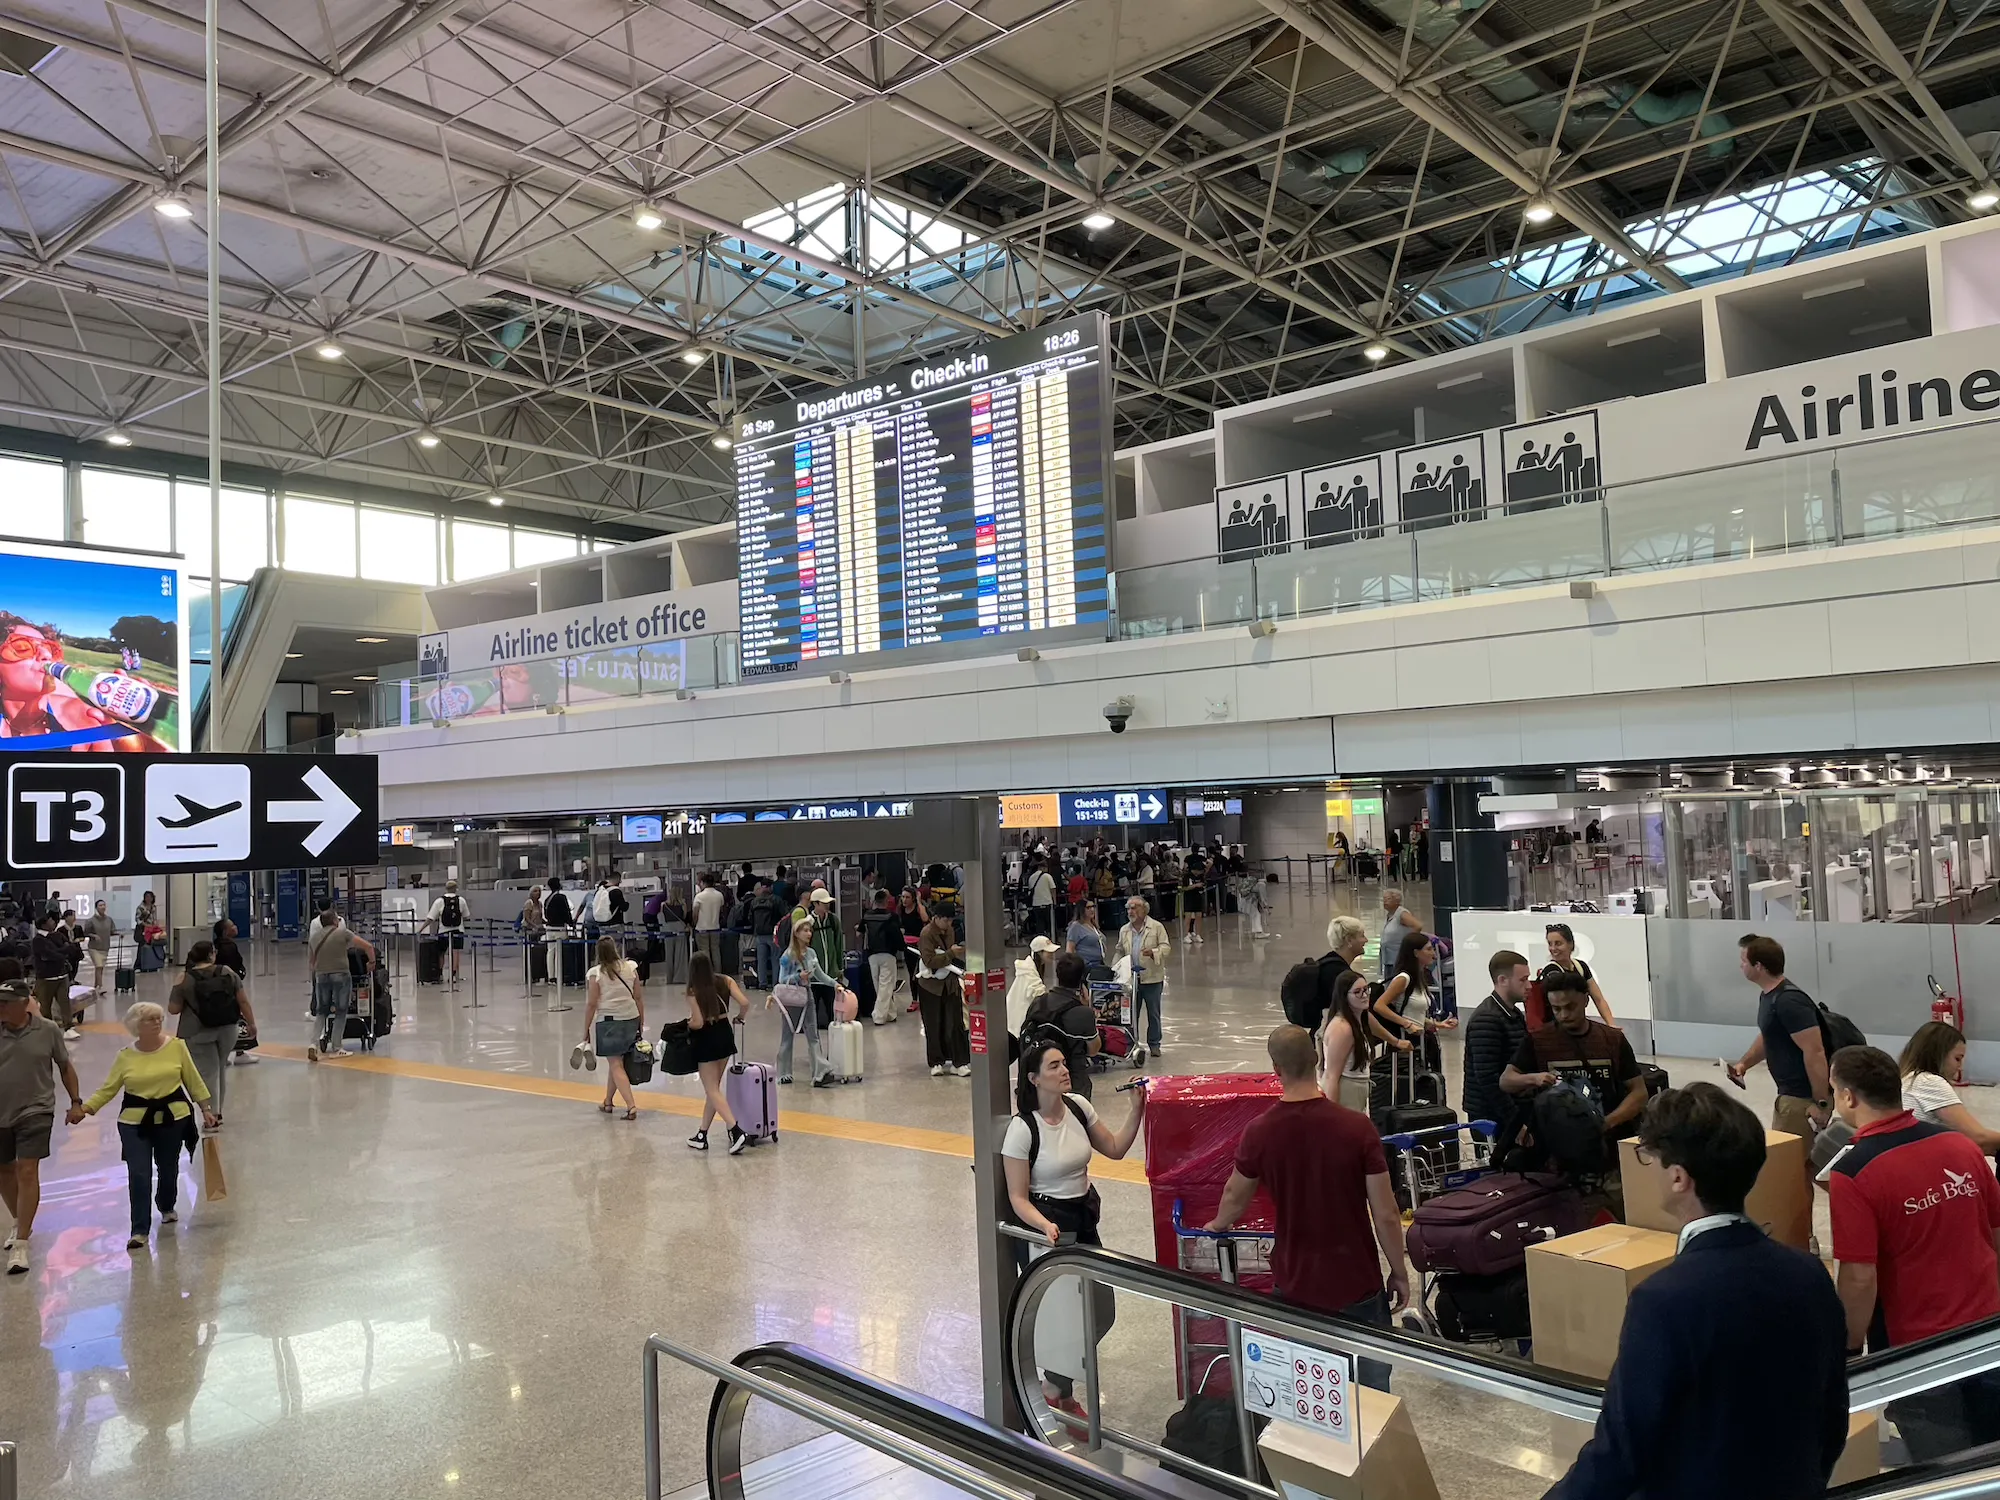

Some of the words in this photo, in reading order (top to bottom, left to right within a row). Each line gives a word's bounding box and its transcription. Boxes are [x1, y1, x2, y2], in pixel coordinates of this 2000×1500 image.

[1043, 329, 1079, 352] 18:26
[971, 383, 988, 392] Airline
[991, 376, 1007, 386] Flight
[1066, 356, 1086, 366] Status
[797, 385, 882, 421] Departures
[910, 353, 988, 389] Check-in
[1745, 368, 2000, 451] Airline
[742, 422, 753, 437] 26
[755, 419, 774, 433] Sep
[916, 440, 928, 448] Paris
[916, 449, 936, 458] Chicago
[917, 469, 928, 477] New
[928, 467, 939, 475] York
[917, 486, 946, 497] Philadelphia
[928, 506, 940, 514] York
[918, 526, 946, 536] Washington
[920, 556, 936, 565] Detroit
[921, 586, 936, 594] Dublin
[921, 596, 939, 604] London
[922, 614, 942, 623] Montreal
[490, 633, 558, 662] Airline
[564, 615, 629, 649] ticket
[636, 604, 707, 641] office
[741, 666, 776, 675] LEDWALL
[779, 663, 797, 672] T3-A
[108, 678, 133, 715] PERONI
[1008, 801, 1043, 811] Customs
[1074, 798, 1110, 809] Check-in
[20, 790, 107, 843] T3
[830, 808, 857, 818] Check-in
[1075, 810, 1109, 821] 151-195
[664, 820, 682, 835] 211
[75, 894, 90, 916] T3
[1904, 1188, 1942, 1215] Safe
[1941, 1181, 1979, 1200] Bag
